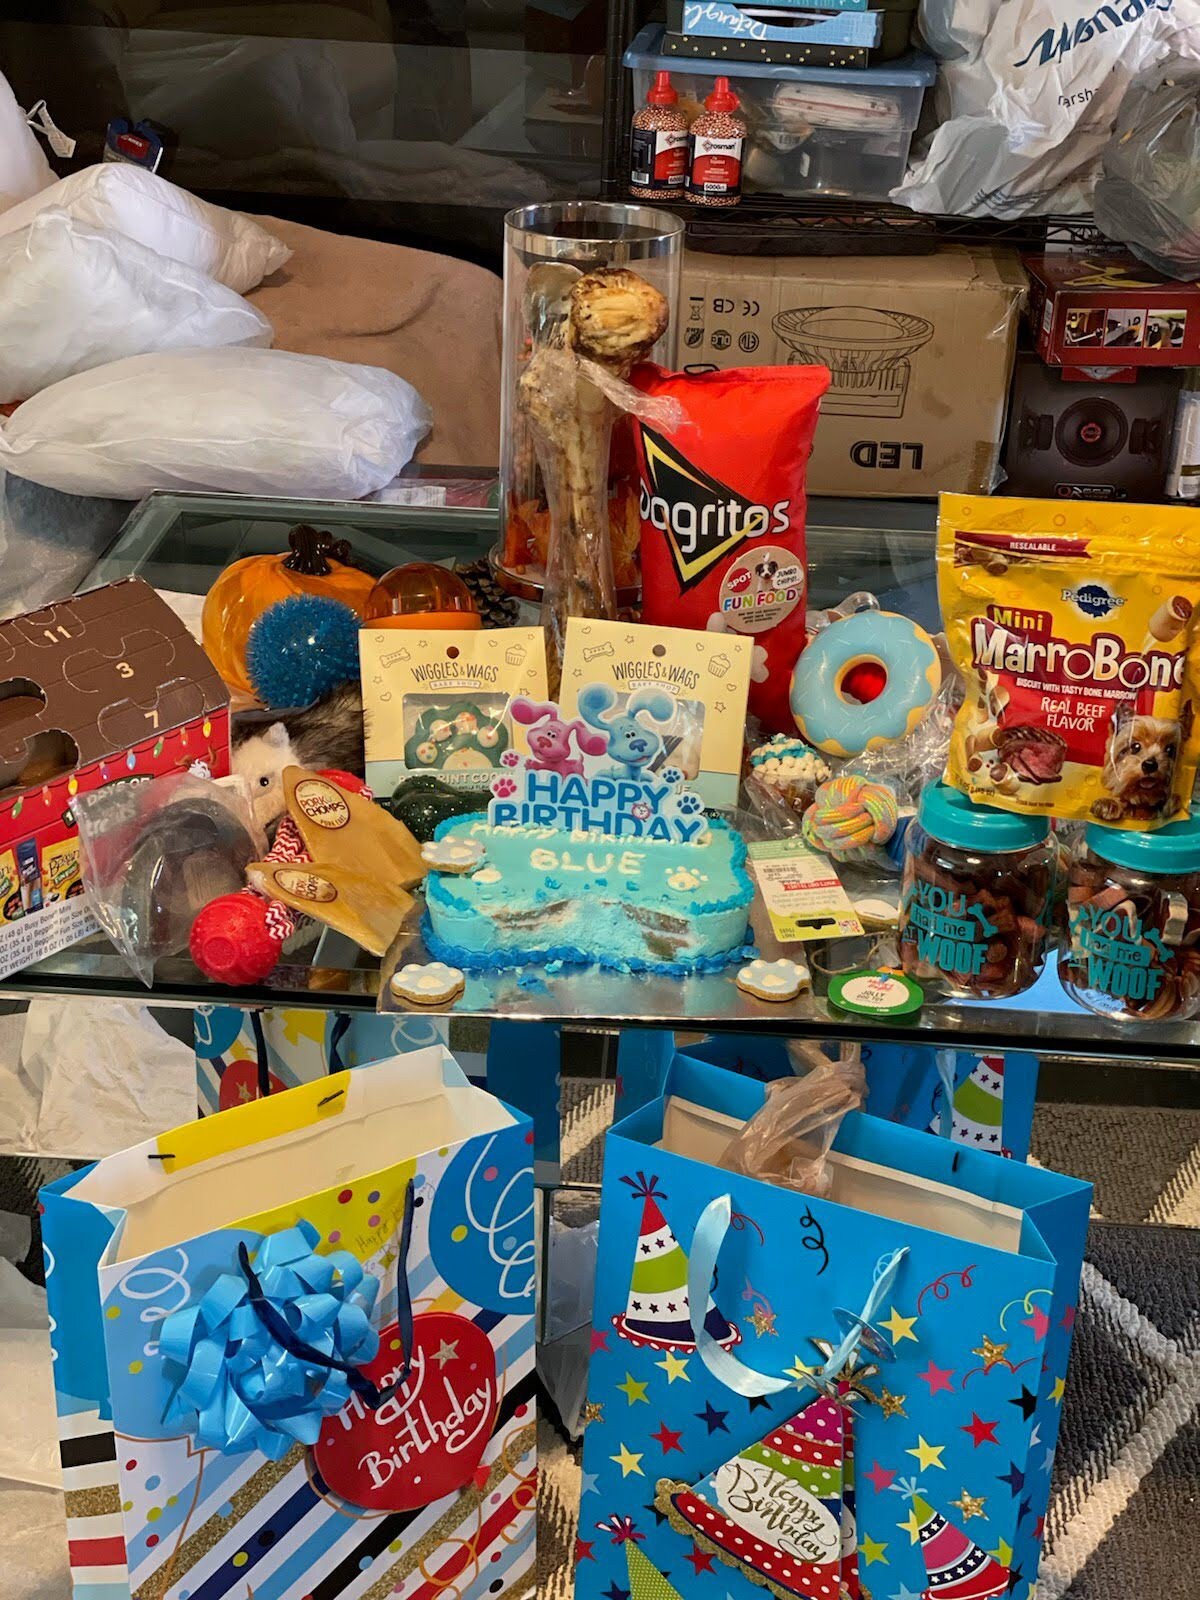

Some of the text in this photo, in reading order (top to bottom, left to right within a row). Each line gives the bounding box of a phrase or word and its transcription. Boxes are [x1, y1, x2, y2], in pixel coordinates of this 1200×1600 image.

[702, 139, 736, 152] Crosman
[851, 440, 924, 470] LED
[1009, 541, 1057, 552] RESEALABLE
[727, 571, 752, 590] SPOT
[723, 589, 797, 612] FUN FOOD
[1061, 589, 1125, 607] Pedigree
[993, 607, 1044, 632] Mini
[43, 625, 72, 643] 11
[115, 661, 135, 679] 3
[410, 661, 460, 682] WIGGLES
[466, 663, 499, 683] WAGS
[611, 661, 661, 681] WIGGLES
[668, 664, 700, 690] WAGS
[1016, 678, 1042, 690] BISCUIT
[1042, 682, 1060, 694] WITH
[1061, 685, 1083, 696] TASTY
[1083, 687, 1103, 698] BONE
[1041, 696, 1106, 718] REAL BEEF
[143, 709, 159, 728] 7
[1047, 714, 1095, 733] FLAVOR
[301, 795, 325, 809] PORK
[527, 773, 670, 813] HAPPY
[305, 801, 347, 817] CHOMPS
[494, 803, 701, 843] BIRTHDAY
[530, 848, 646, 875] BLUE
[918, 879, 967, 917] YOU
[943, 922, 967, 937] me
[1089, 904, 1143, 942] YOU
[9, 953, 35, 970] WEIGHT
[917, 928, 989, 976] WOOF
[1116, 947, 1142, 962] me
[1088, 955, 1165, 1001] WOOF
[336, 1345, 425, 1431] Hppy
[357, 1376, 492, 1491] Birthday
[725, 1463, 827, 1563] Birthday
[753, 1466, 838, 1547] Happy
